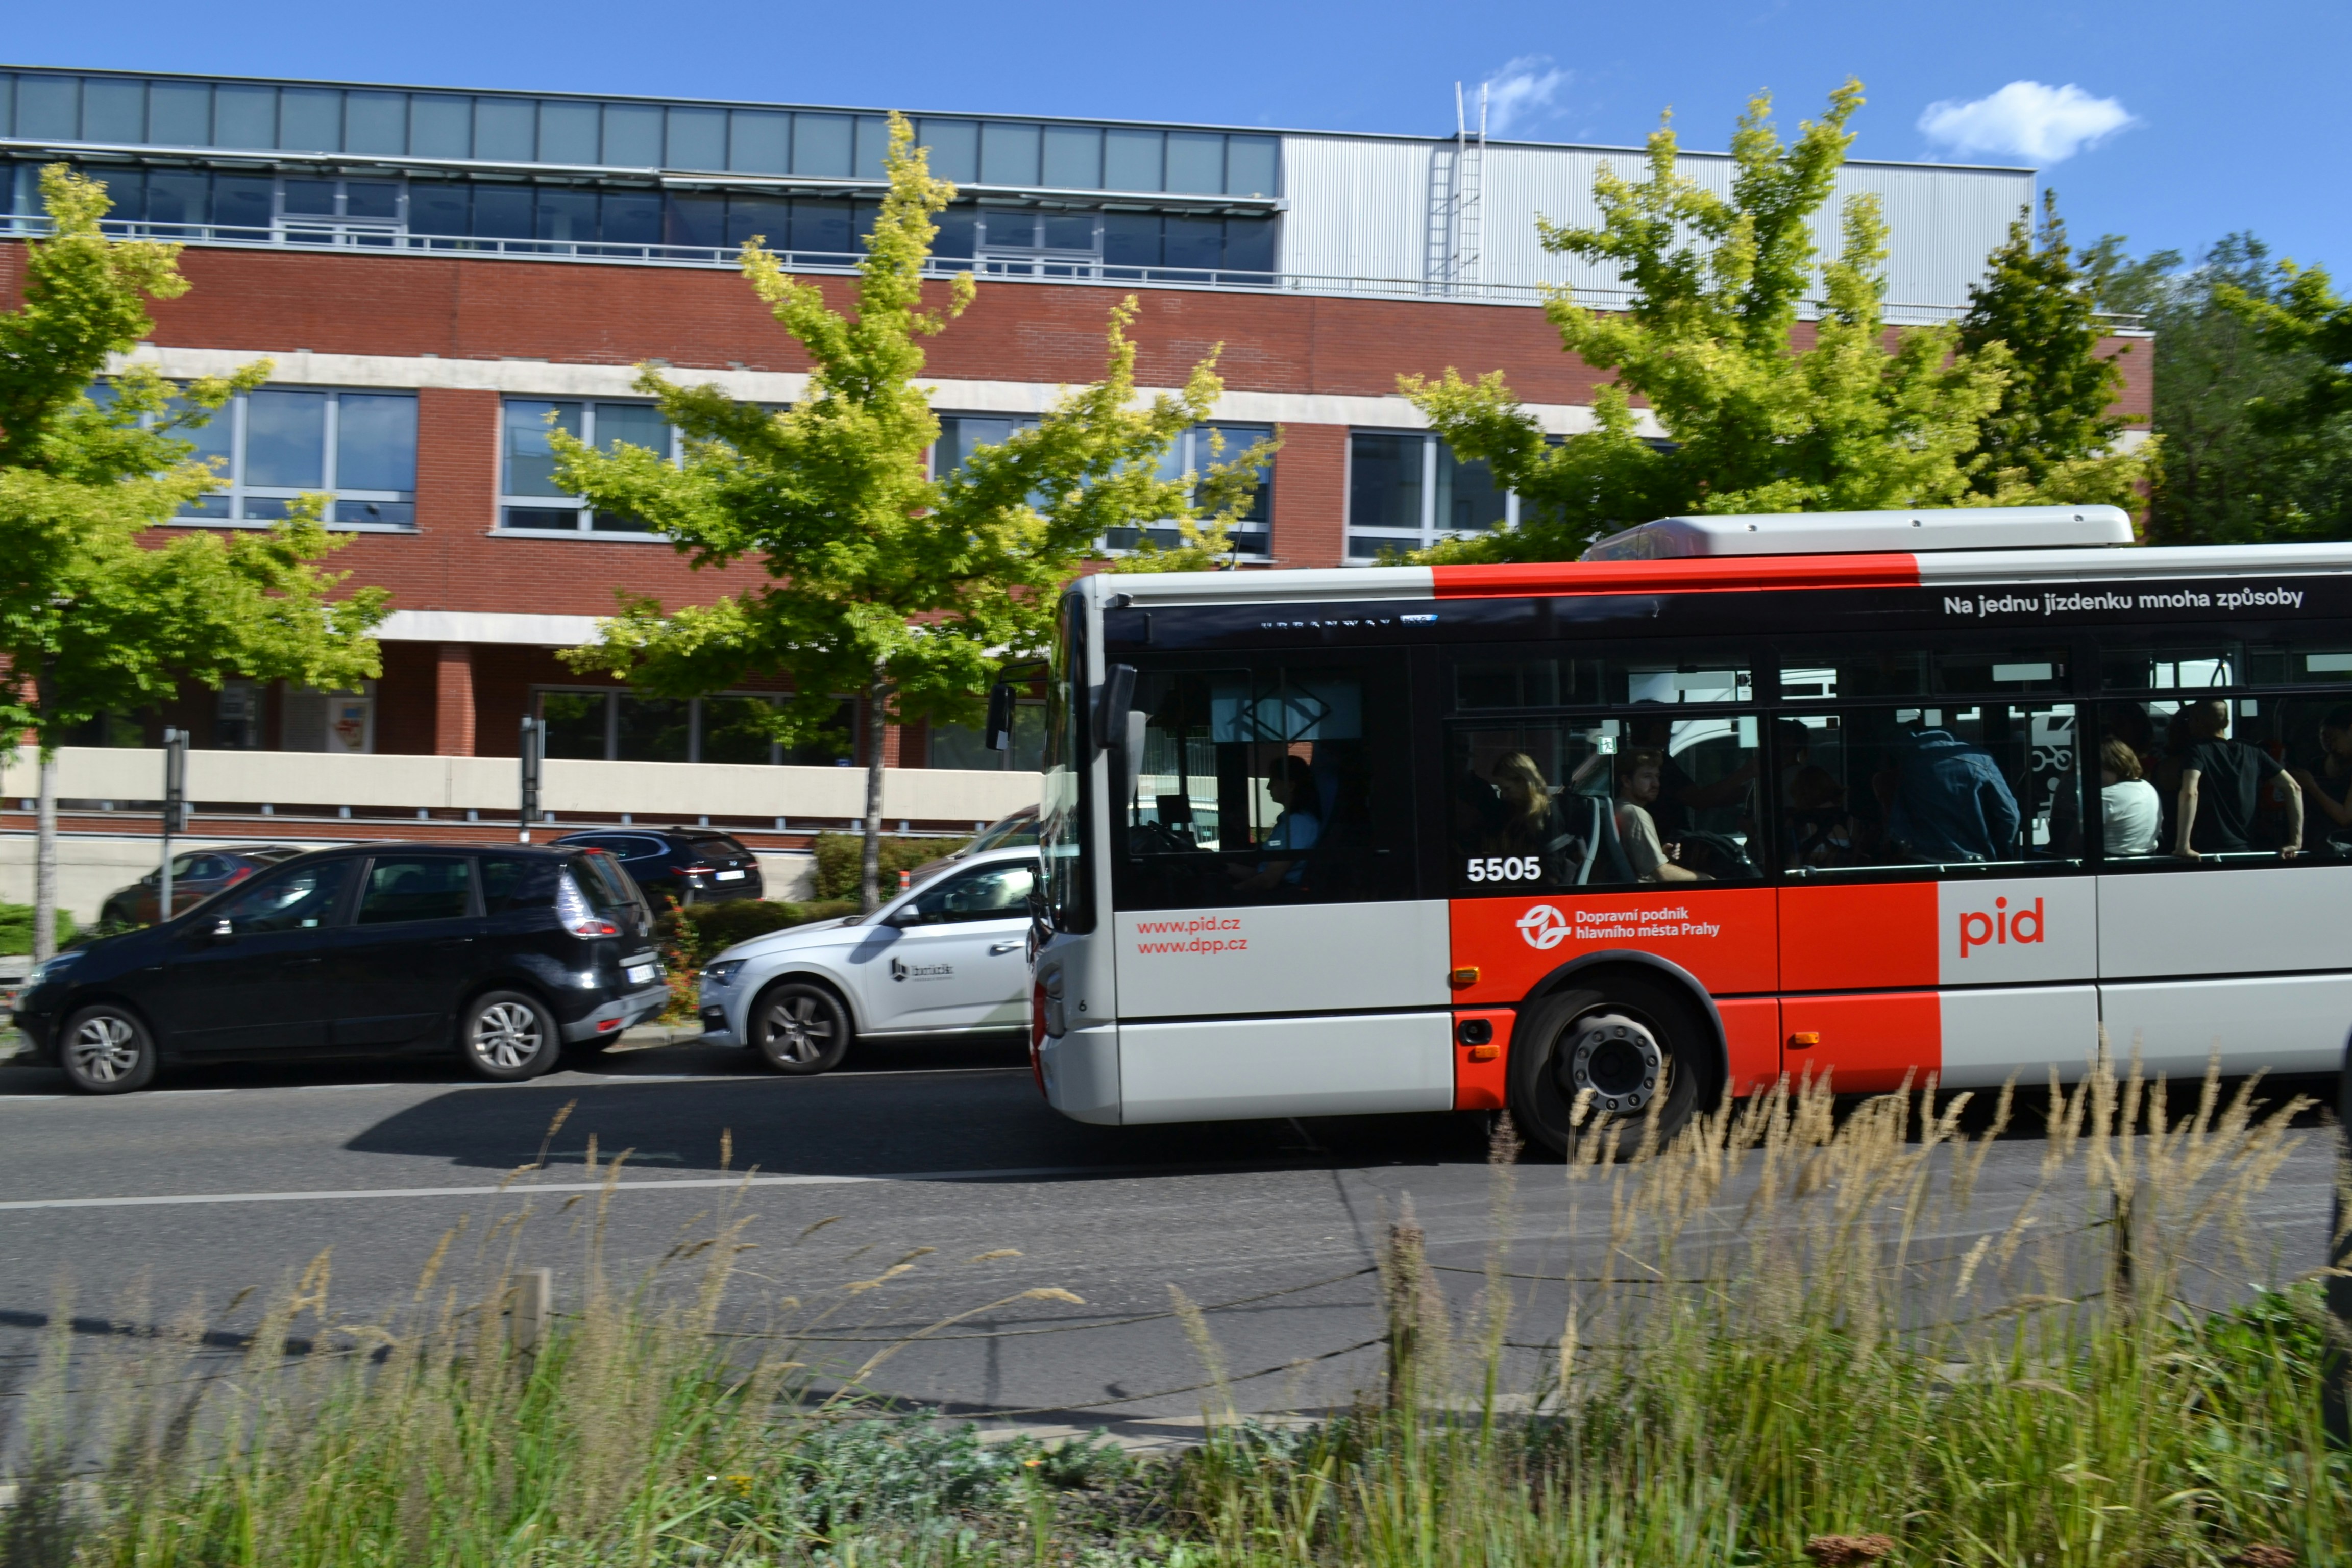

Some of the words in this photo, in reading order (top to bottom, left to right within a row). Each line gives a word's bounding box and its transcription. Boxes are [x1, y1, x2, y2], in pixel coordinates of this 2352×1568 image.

[1944, 596, 1973, 614] Na
[1978, 594, 2039, 617] jednu
[2044, 592, 2133, 616] jízdenku
[2138, 590, 2211, 608] mnoha
[2216, 587, 2303, 610] způsoby
[1467, 856, 1541, 882] 5505
[1576, 908, 1638, 924] Dopravní
[1640, 906, 1689, 923] podnik
[1137, 916, 1241, 935] www.pid.cz
[1576, 925, 1635, 940] hlavního
[1637, 923, 1678, 937] města
[1681, 922, 1721, 938] Prahy
[1959, 896, 2044, 958] pid
[1137, 937, 1247, 955] www.dpp.cz
[1078, 1000, 1087, 1012] 6
